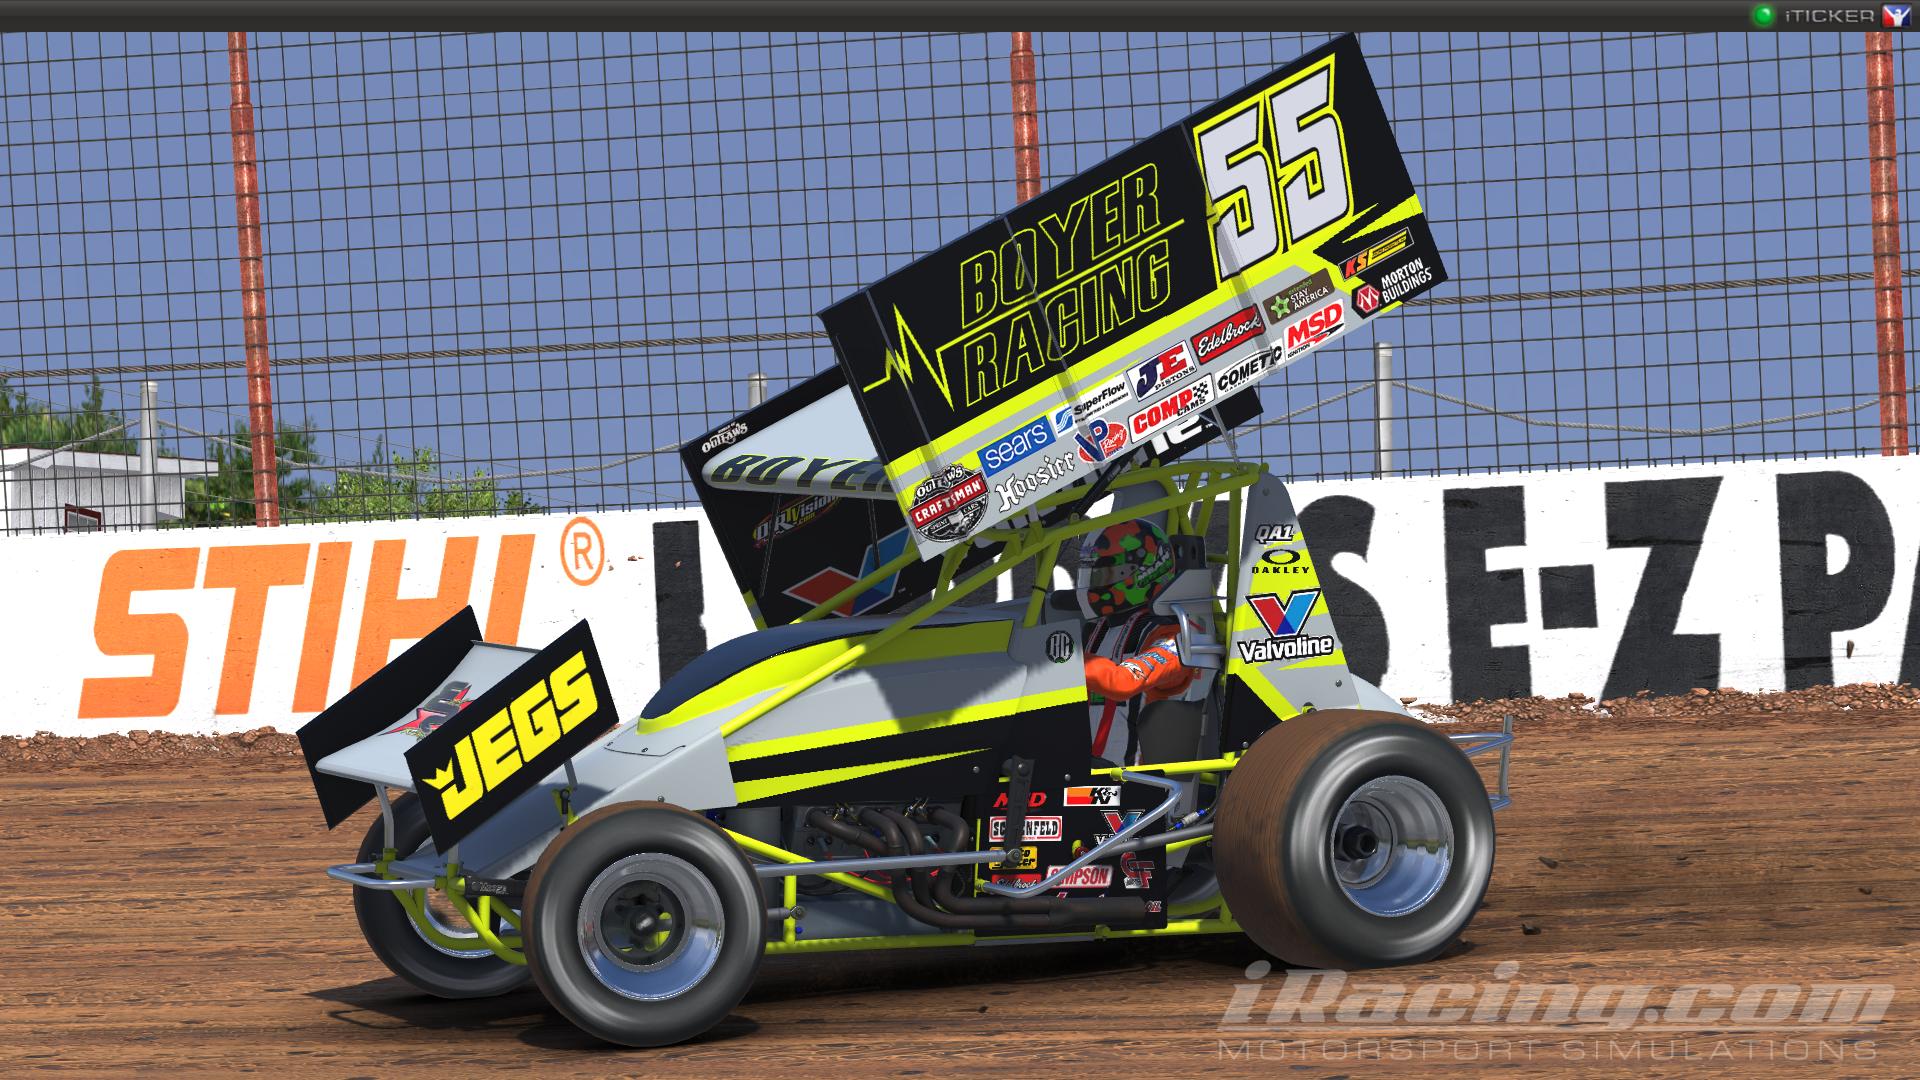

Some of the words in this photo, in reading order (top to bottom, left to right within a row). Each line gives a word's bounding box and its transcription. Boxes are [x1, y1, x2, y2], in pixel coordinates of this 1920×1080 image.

[1194, 56, 1353, 283] 55
[961, 163, 1161, 330] BOYER
[1381, 257, 1424, 290] MORTON
[1382, 266, 1433, 303] BUILDINGS
[1290, 287, 1310, 303] STAY
[1294, 286, 1329, 310] AMERICA
[963, 239, 1171, 408] RACING
[1198, 311, 1262, 357] Edelbrock
[1288, 303, 1343, 349] MSD
[1136, 344, 1188, 398] JE
[1155, 365, 1196, 391] PISTONS
[1218, 345, 1283, 391] COMETIC
[1133, 388, 1193, 435] COMP
[1177, 396, 1207, 417] CAMS
[985, 424, 1048, 469] sears
[995, 452, 1075, 512] Hoosier
[915, 482, 981, 523] CRAFTSMAN
[963, 502, 979, 514] CARS
[1255, 524, 1295, 544] QA1
[1252, 566, 1310, 574] OAKLEY
[1776, 471, 1920, 694] P
[1237, 636, 1335, 664] Valvoline
[440, 650, 599, 821] JEGS
[993, 791, 1048, 808] MD
[993, 820, 1060, 836] SCNFELD
[1050, 866, 1110, 886] SMPSON
